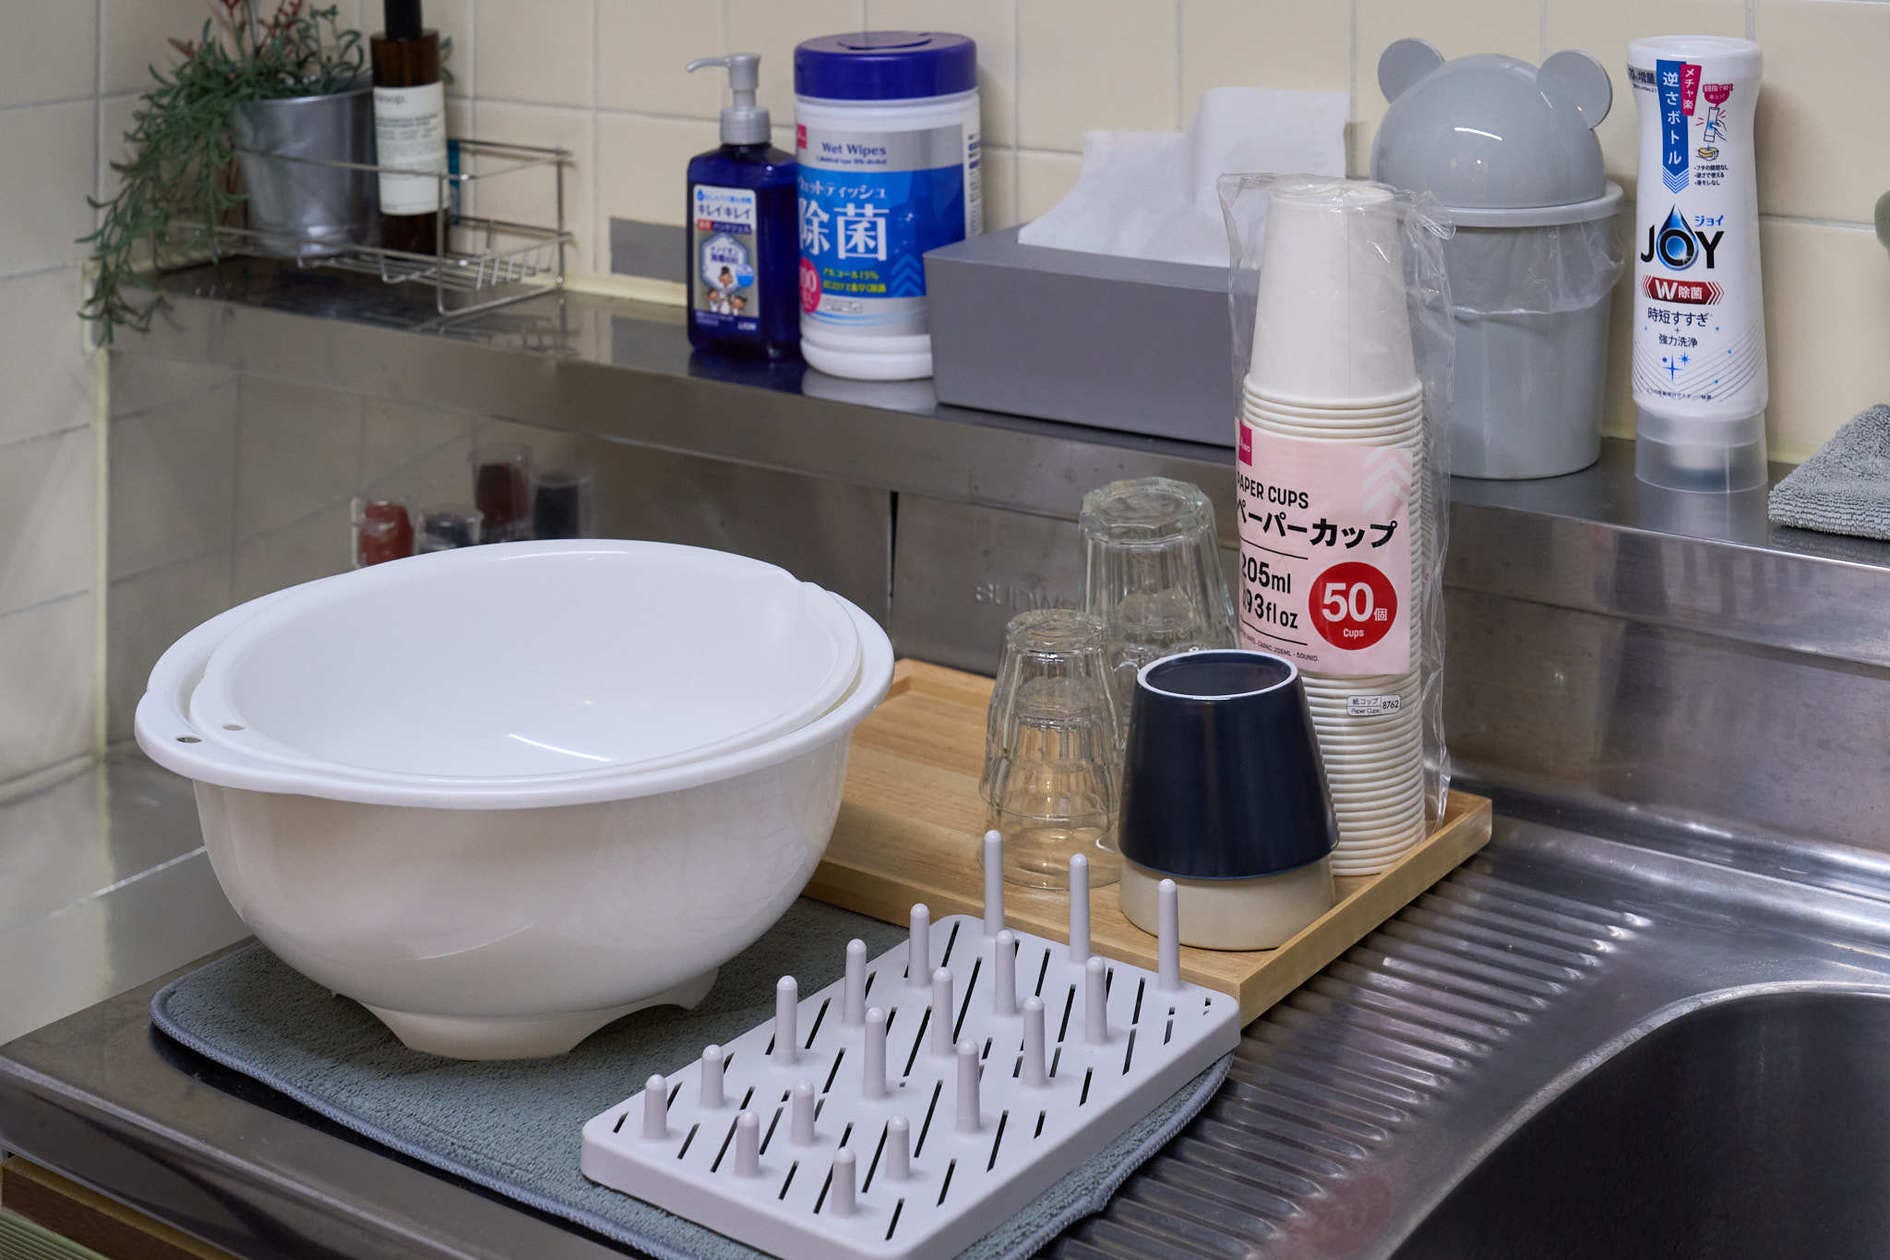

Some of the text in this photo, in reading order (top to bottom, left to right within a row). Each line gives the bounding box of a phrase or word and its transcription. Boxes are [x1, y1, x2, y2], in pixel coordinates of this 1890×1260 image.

[1682, 68, 1696, 110] メチャ楽
[1663, 72, 1682, 165] 逆さボトル
[822, 141, 888, 158] Wet Wipes
[698, 203, 752, 221] キレイキレイ
[1695, 214, 1725, 227] ジョイ
[799, 197, 890, 261] 除菌
[1640, 224, 1725, 270] JOY
[1655, 279, 1703, 300] W除菌
[1647, 306, 1710, 328] 時短すすぎ
[1659, 333, 1699, 348] 強力洗浄
[1268, 485, 1310, 510] CUPS
[1239, 497, 1399, 549] ペーパーカップ
[1343, 627, 1365, 641] Cups
[1382, 700, 1400, 710] 8762
